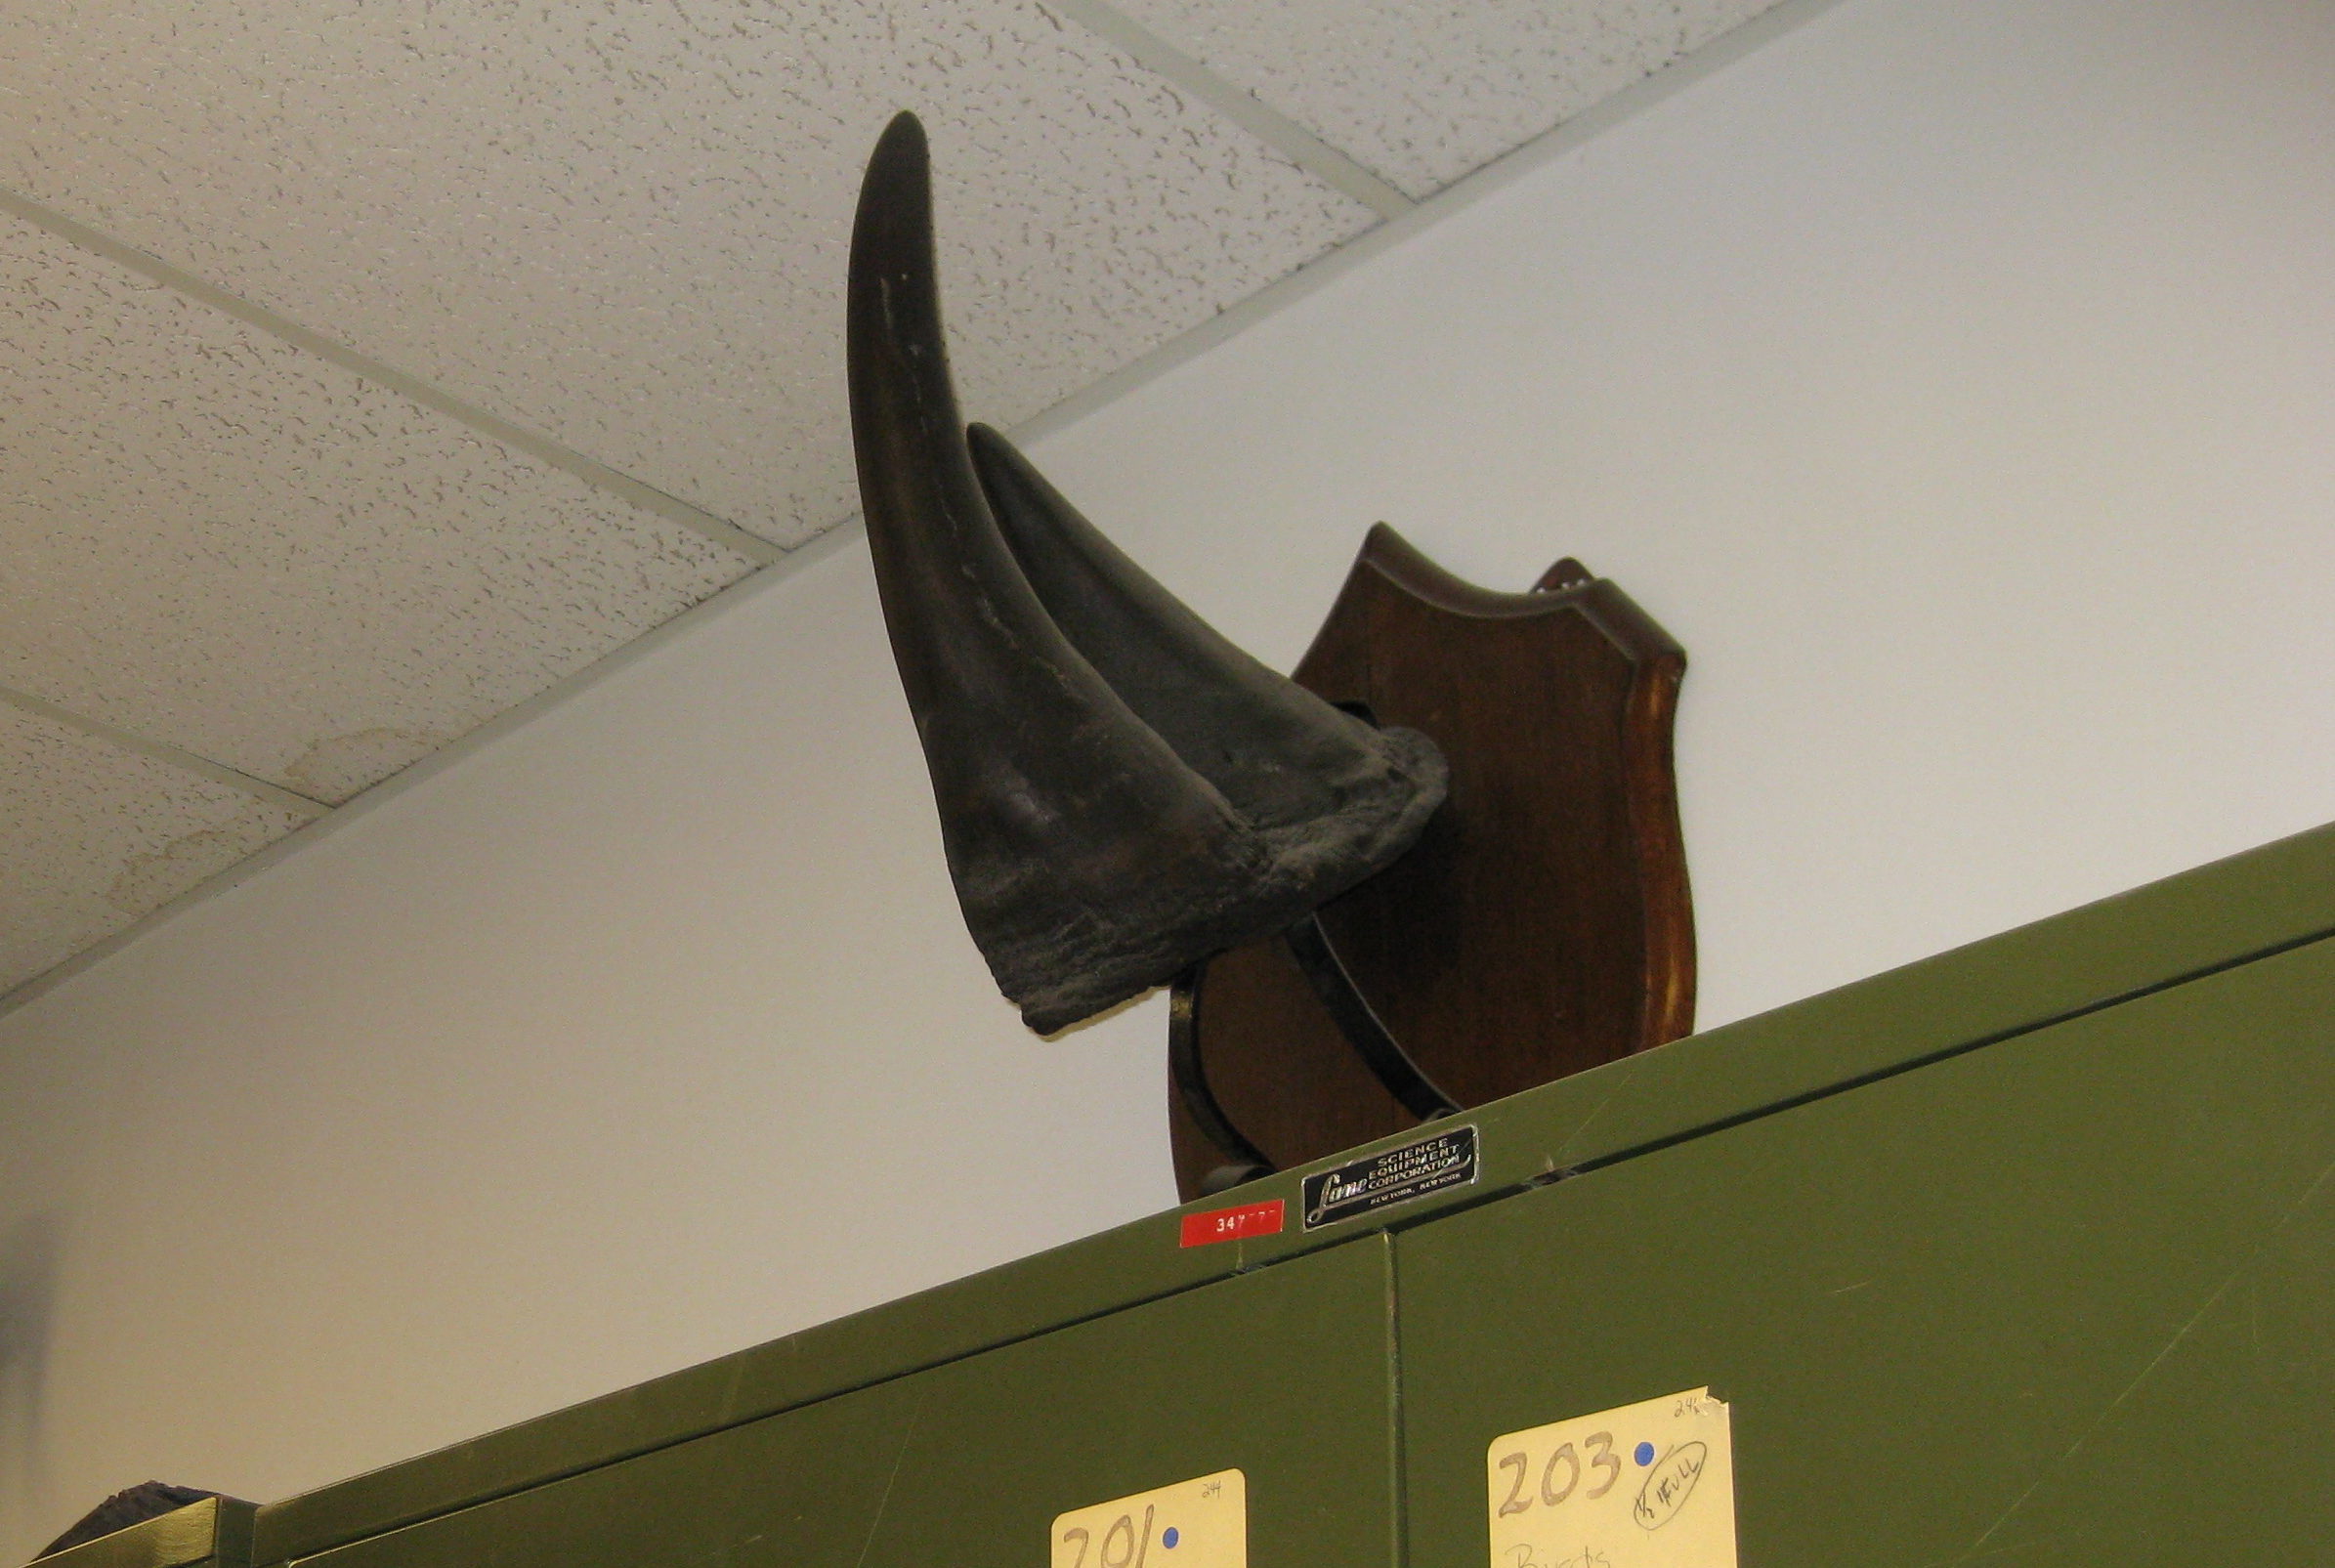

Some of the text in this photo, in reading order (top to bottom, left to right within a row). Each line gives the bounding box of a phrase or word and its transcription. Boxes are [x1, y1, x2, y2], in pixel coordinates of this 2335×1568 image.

[1369, 1143, 1460, 1180] EQUIPMENT
[1378, 1137, 1448, 1167] SCIENCE
[1368, 1155, 1460, 1190] CORPORATION
[1370, 1195, 1387, 1206] NEW
[1499, 1430, 1622, 1519] 203
